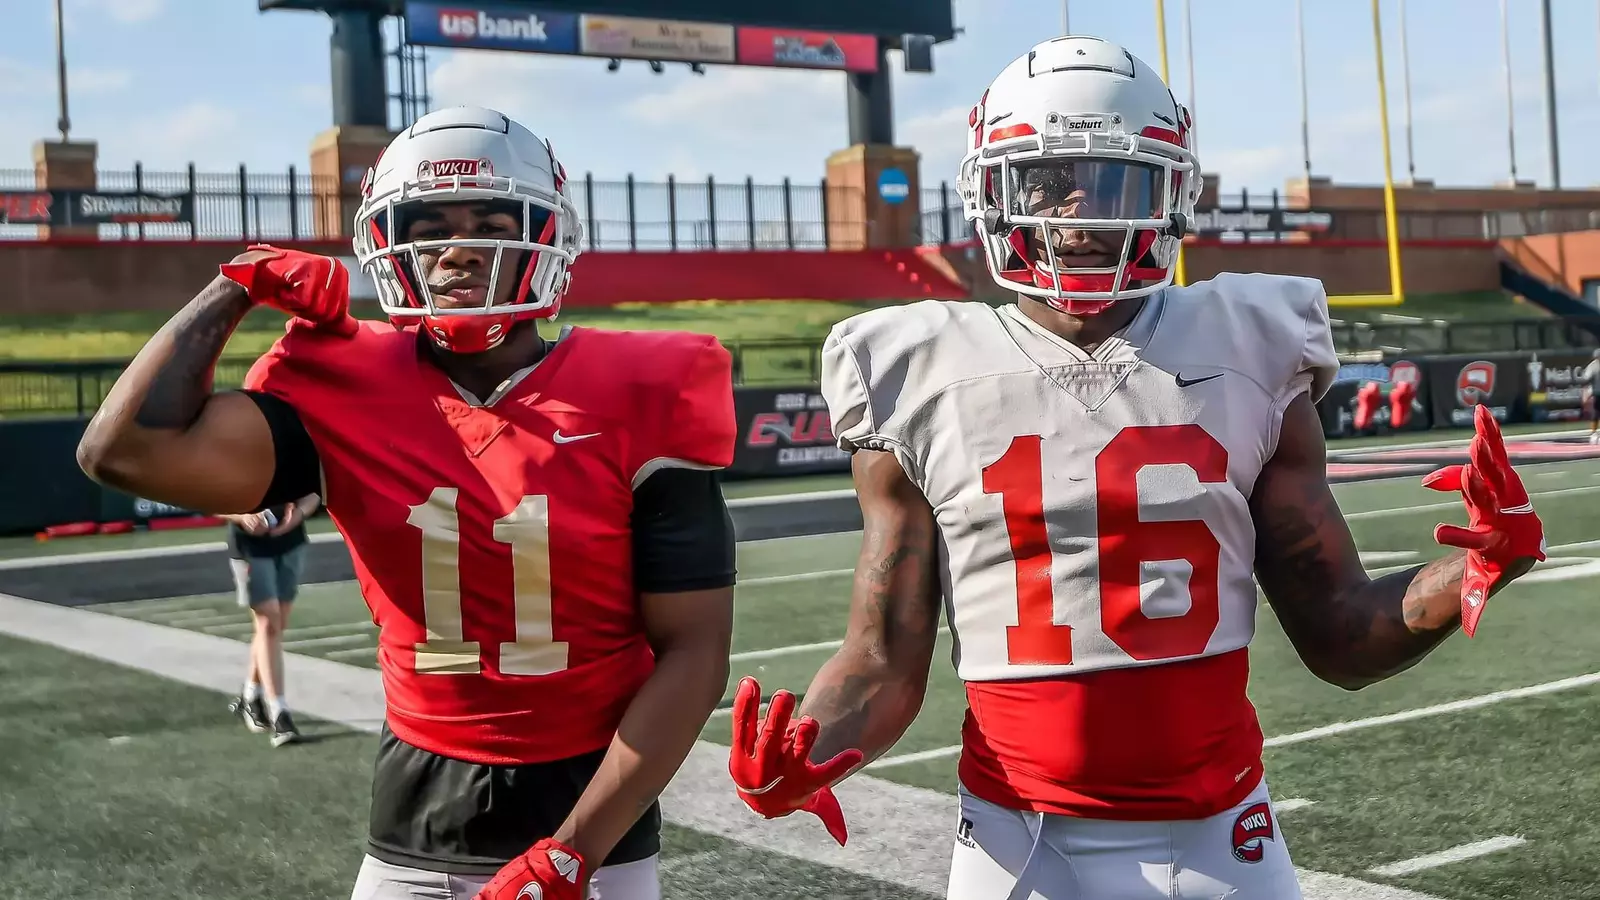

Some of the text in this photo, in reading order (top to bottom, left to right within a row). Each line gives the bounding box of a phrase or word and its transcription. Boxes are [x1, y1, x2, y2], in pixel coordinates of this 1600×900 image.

[1068, 119, 1103, 129] schutt
[436, 162, 473, 175] WKU
[981, 423, 1229, 665] 16
[406, 486, 569, 676] 11
[1240, 812, 1268, 832] WKU
